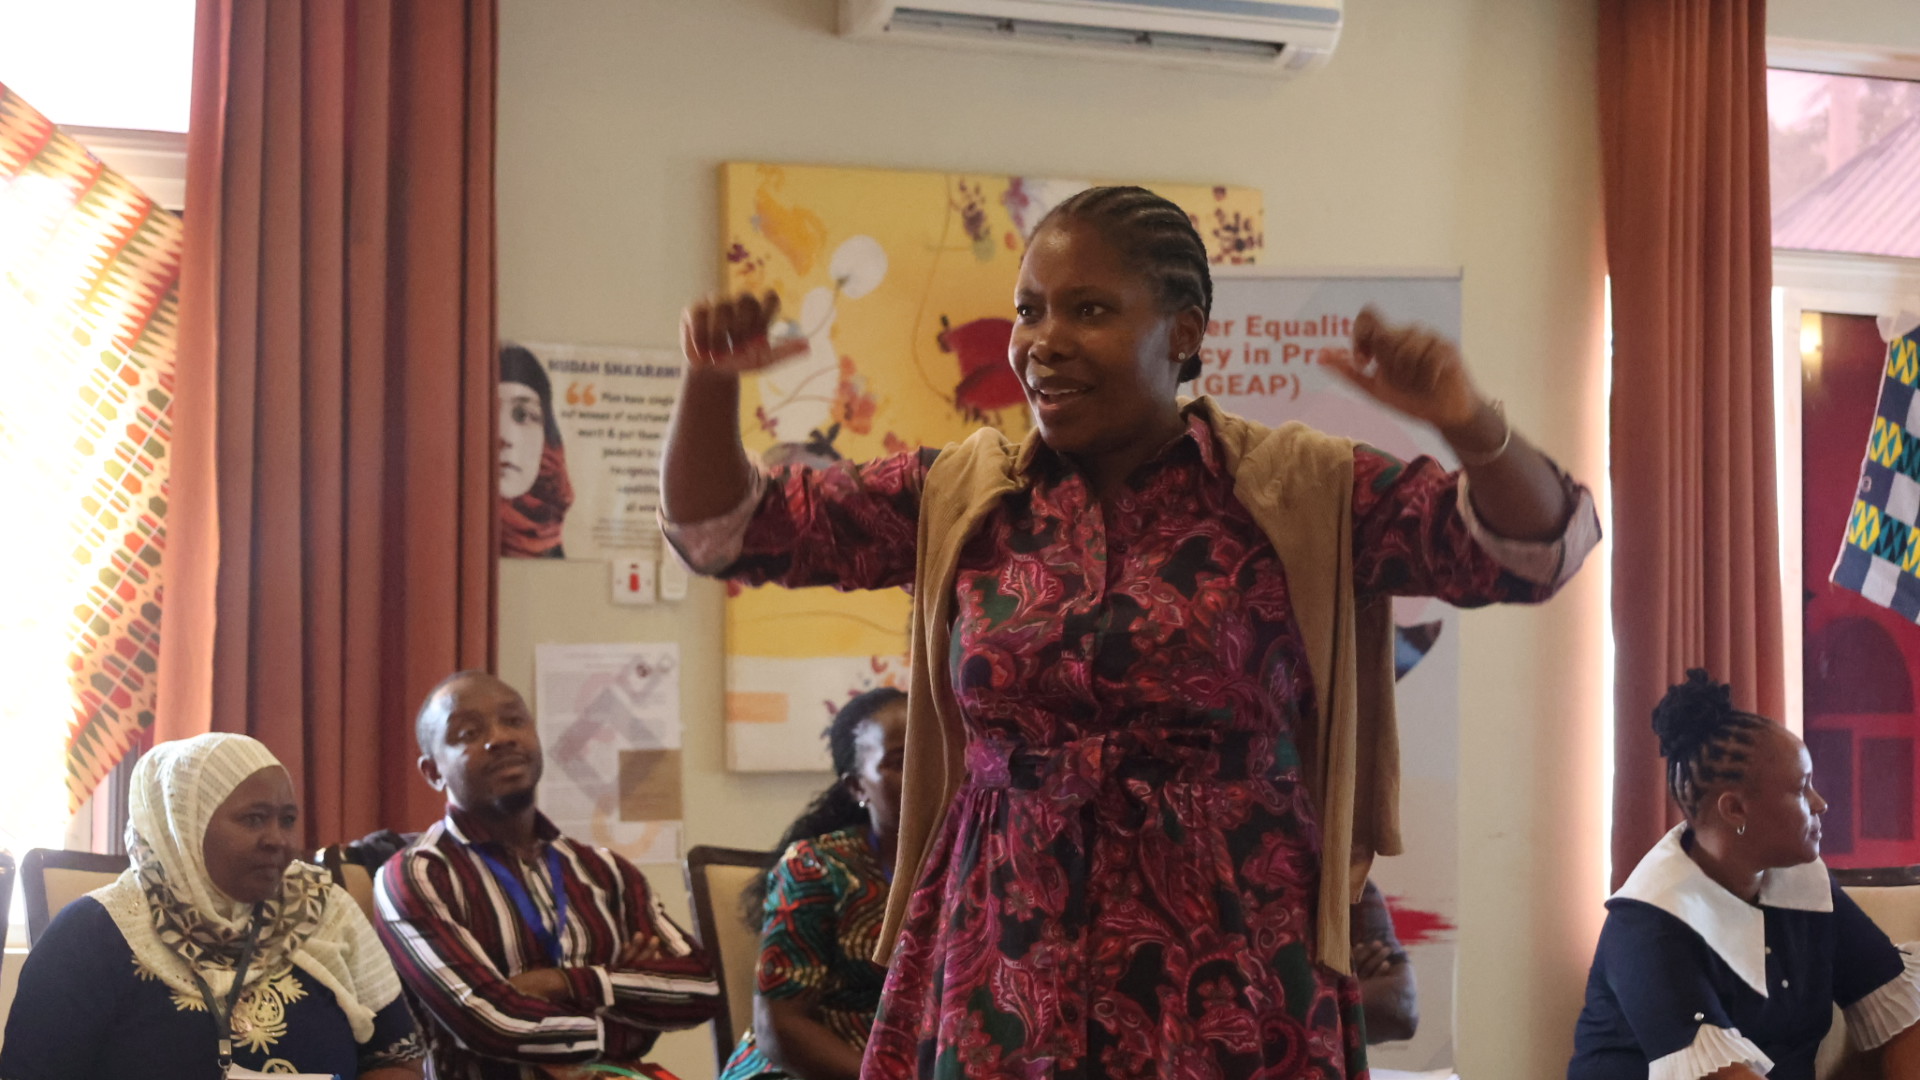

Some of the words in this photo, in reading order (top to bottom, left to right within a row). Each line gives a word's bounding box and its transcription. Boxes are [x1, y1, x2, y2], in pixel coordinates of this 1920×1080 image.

[1206, 319, 1236, 338] er
[1246, 314, 1353, 341] Equalit
[1200, 346, 1233, 369] cy
[1244, 342, 1271, 364] in
[1192, 372, 1301, 400] (GEAP)
